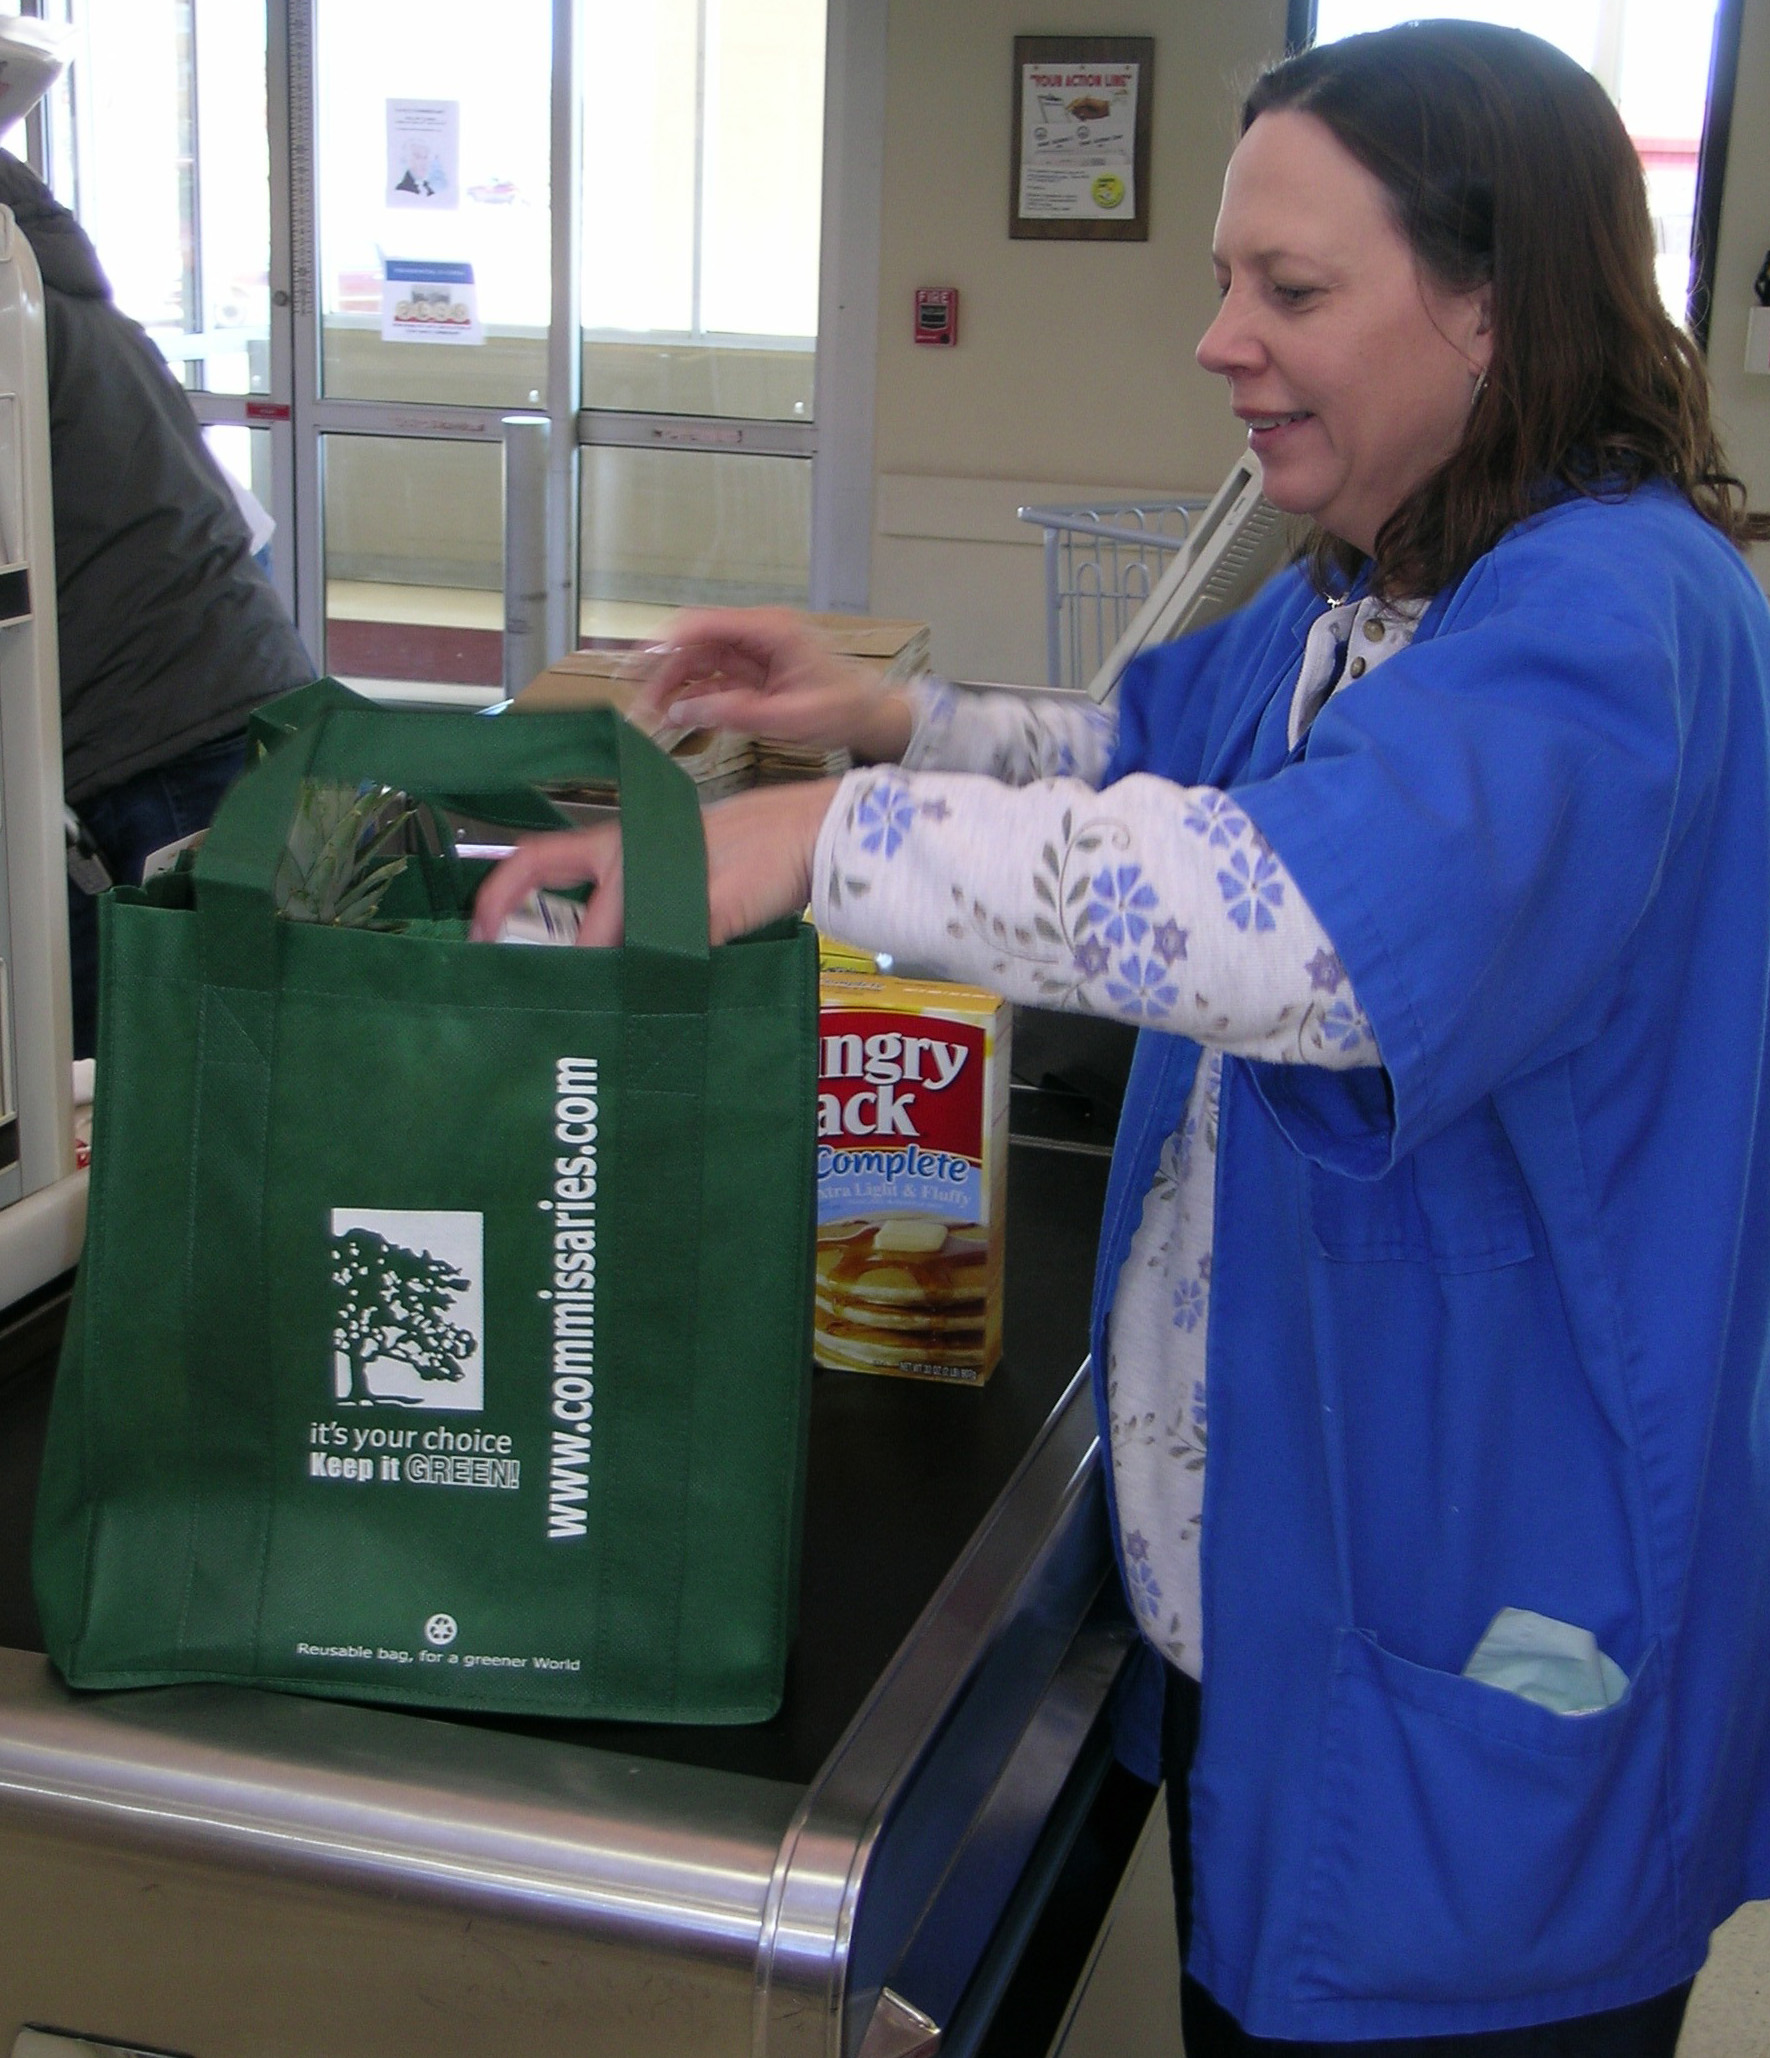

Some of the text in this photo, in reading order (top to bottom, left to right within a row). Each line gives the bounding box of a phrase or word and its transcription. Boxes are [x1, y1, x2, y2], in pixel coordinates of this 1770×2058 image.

[819, 1032, 969, 1091] ngry
[818, 1084, 921, 1137] ack
[818, 1143, 969, 1184] Complete
[818, 1185, 851, 1200] xtra
[855, 1182, 898, 1201] Light
[902, 1184, 917, 1198] &
[920, 1184, 972, 1209] Fluffy
[537, 1056, 598, 1539] www.commissaries.com
[309, 1422, 513, 1454] it's your choice
[309, 1452, 521, 1490] Keep it GREEN!
[296, 1642, 581, 1672] Reusable bag, for a greener World
